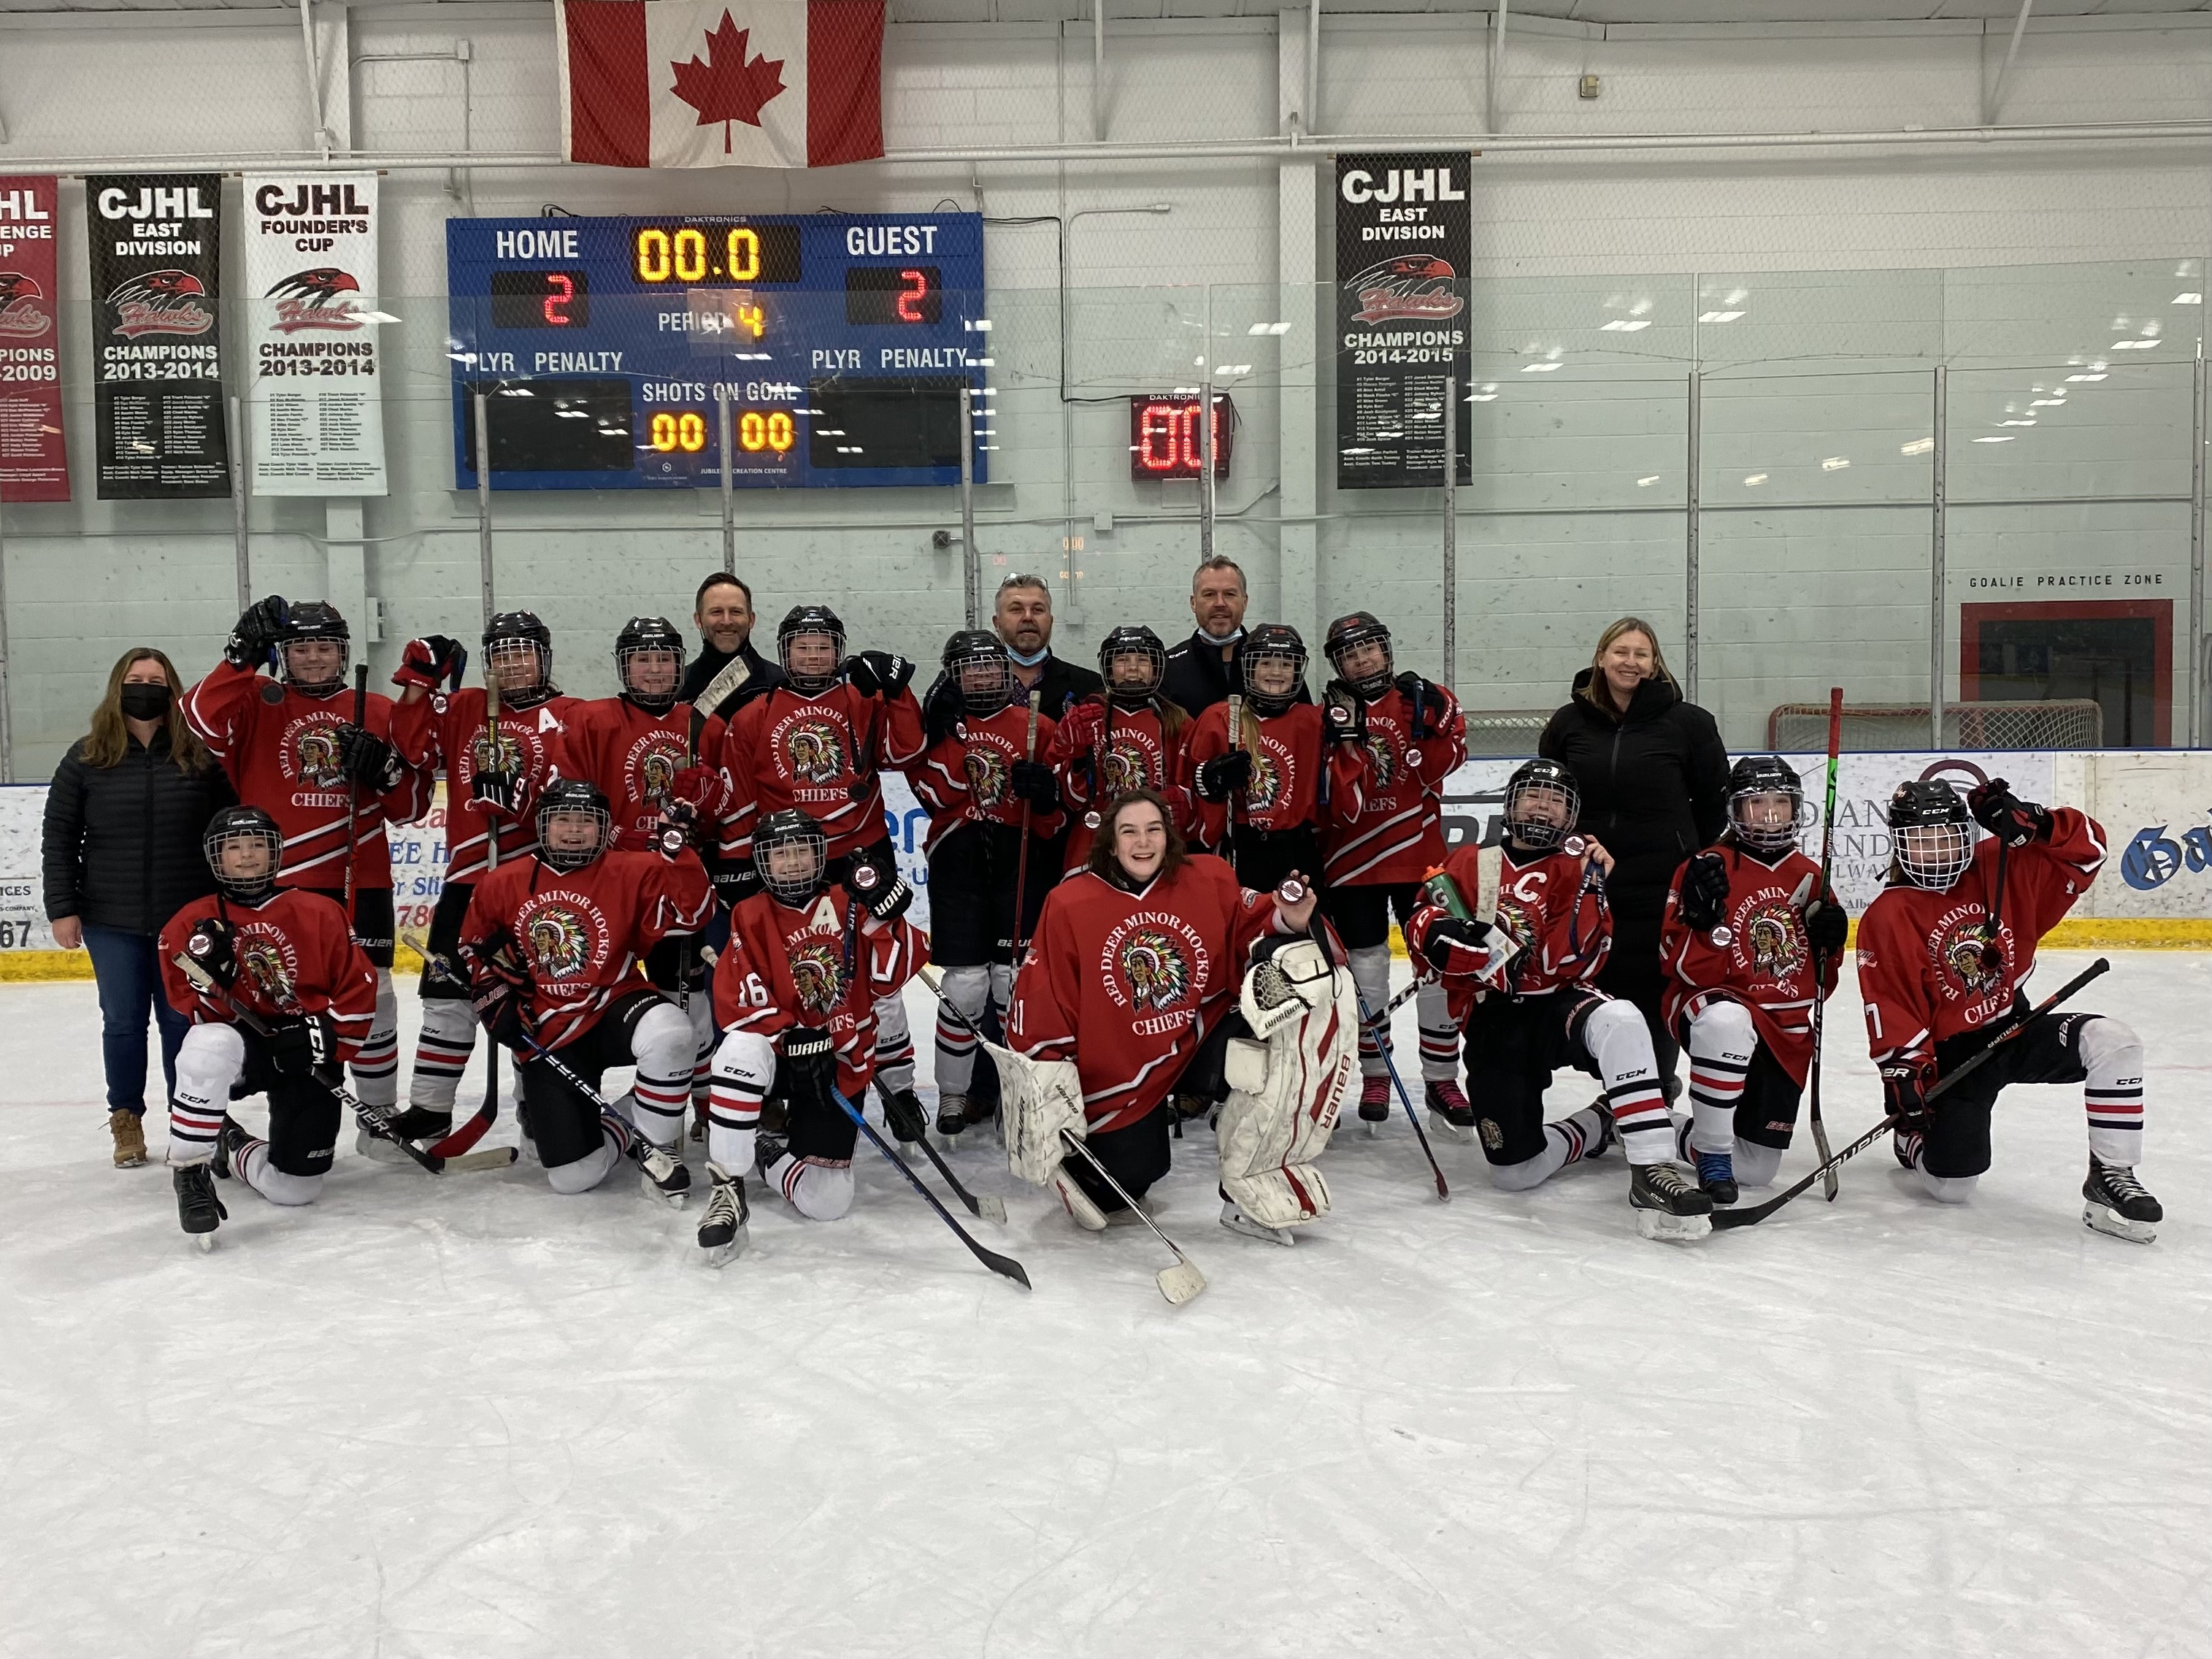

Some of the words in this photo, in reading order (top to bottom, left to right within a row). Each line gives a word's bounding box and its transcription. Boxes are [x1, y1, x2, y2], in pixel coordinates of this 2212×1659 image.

[1342, 168, 1464, 203] CJHL
[99, 187, 212, 219] CJHL
[256, 184, 369, 216] CJHL
[1380, 207, 1427, 222] EAST
[133, 223, 182, 237] EAST
[261, 220, 368, 234] FOUNDER'S
[1362, 226, 1445, 241] DIVISION
[115, 242, 201, 256] DIVISION
[295, 238, 334, 252] CUP
[496, 230, 579, 258] HOME
[846, 226, 937, 256] GUEST
[637, 228, 759, 281] 00.0
[545, 274, 573, 324] 2
[898, 270, 927, 321] 2
[739, 306, 763, 337] 4
[259, 342, 372, 357] CHAMPIONS
[1344, 331, 1464, 348] CHAMPIONS
[104, 345, 218, 361] CHAMPIONS
[465, 353, 515, 372] PLYR
[535, 351, 623, 372] PENALTY
[812, 349, 861, 369] PLYR
[880, 348, 968, 368] PENALTY
[1354, 348, 1453, 364] 2014-2015
[104, 361, 219, 380] 2013-2014
[260, 359, 374, 377] 2013-2014
[642, 383, 705, 402] SHOTS
[713, 382, 739, 401] ON
[747, 382, 797, 401] GOAL
[652, 413, 704, 451] 00
[741, 412, 792, 451] 00
[1970, 577, 2025, 588] GOALIE
[2038, 575, 2113, 586] PRACTICE
[2124, 573, 2163, 585] ZONE
[538, 707, 559, 735] A
[794, 706, 843, 724] MINOR
[770, 716, 794, 750] DEER
[967, 732, 1014, 753] MINOR
[279, 748, 293, 779] RED
[304, 710, 347, 725] MINO
[624, 736, 650, 771] DEER
[1365, 716, 1396, 731] INOR
[1393, 729, 1410, 787] HOEY
[459, 756, 471, 786] RED
[529, 734, 545, 783] HOCKE
[772, 751, 788, 780] RED
[1110, 727, 1155, 751] MINOR
[1151, 749, 1163, 786] HOC
[1534, 767, 1559, 777] CC
[625, 773, 640, 802] RED
[794, 787, 849, 802] CHIEFS
[291, 792, 352, 808] CHIEFS
[1363, 797, 1397, 813] IEFS
[1922, 806, 1950, 815] CCM
[1432, 887, 1450, 908] G
[1513, 872, 1547, 902] C
[1787, 873, 1815, 908] A
[810, 896, 842, 932] A
[1124, 912, 1181, 930] MINOR
[514, 899, 537, 938] DEER
[537, 890, 591, 910] MINOR
[588, 906, 610, 970] HOCKEY
[1732, 895, 1758, 935] DEER
[1756, 886, 1791, 901] MIN
[1794, 914, 1809, 976] OCKEY
[1101, 925, 1127, 971] DEER
[1991, 914, 2015, 972] OCKEY
[240, 922, 286, 949] MINOR
[282, 942, 299, 988] HOCK
[1180, 923, 1209, 993] HOCKEY
[538, 982, 591, 997] HIEFS
[738, 972, 768, 1008] 16
[1102, 975, 1128, 1008] RED
[826, 1012, 856, 1032] EFS
[1011, 999, 1024, 1036] 31
[1132, 1008, 1197, 1035] CHIEFS
[1264, 1002, 1305, 1030] WARRIOR
[370, 1029, 394, 1039] CCM
[880, 1031, 904, 1044] CCM
[1721, 1051, 1750, 1062] CCM
[669, 1068, 694, 1077] CCM
[723, 1065, 756, 1078] CCM
[1616, 1068, 1648, 1081] CCM
[180, 1092, 211, 1105] CCM
